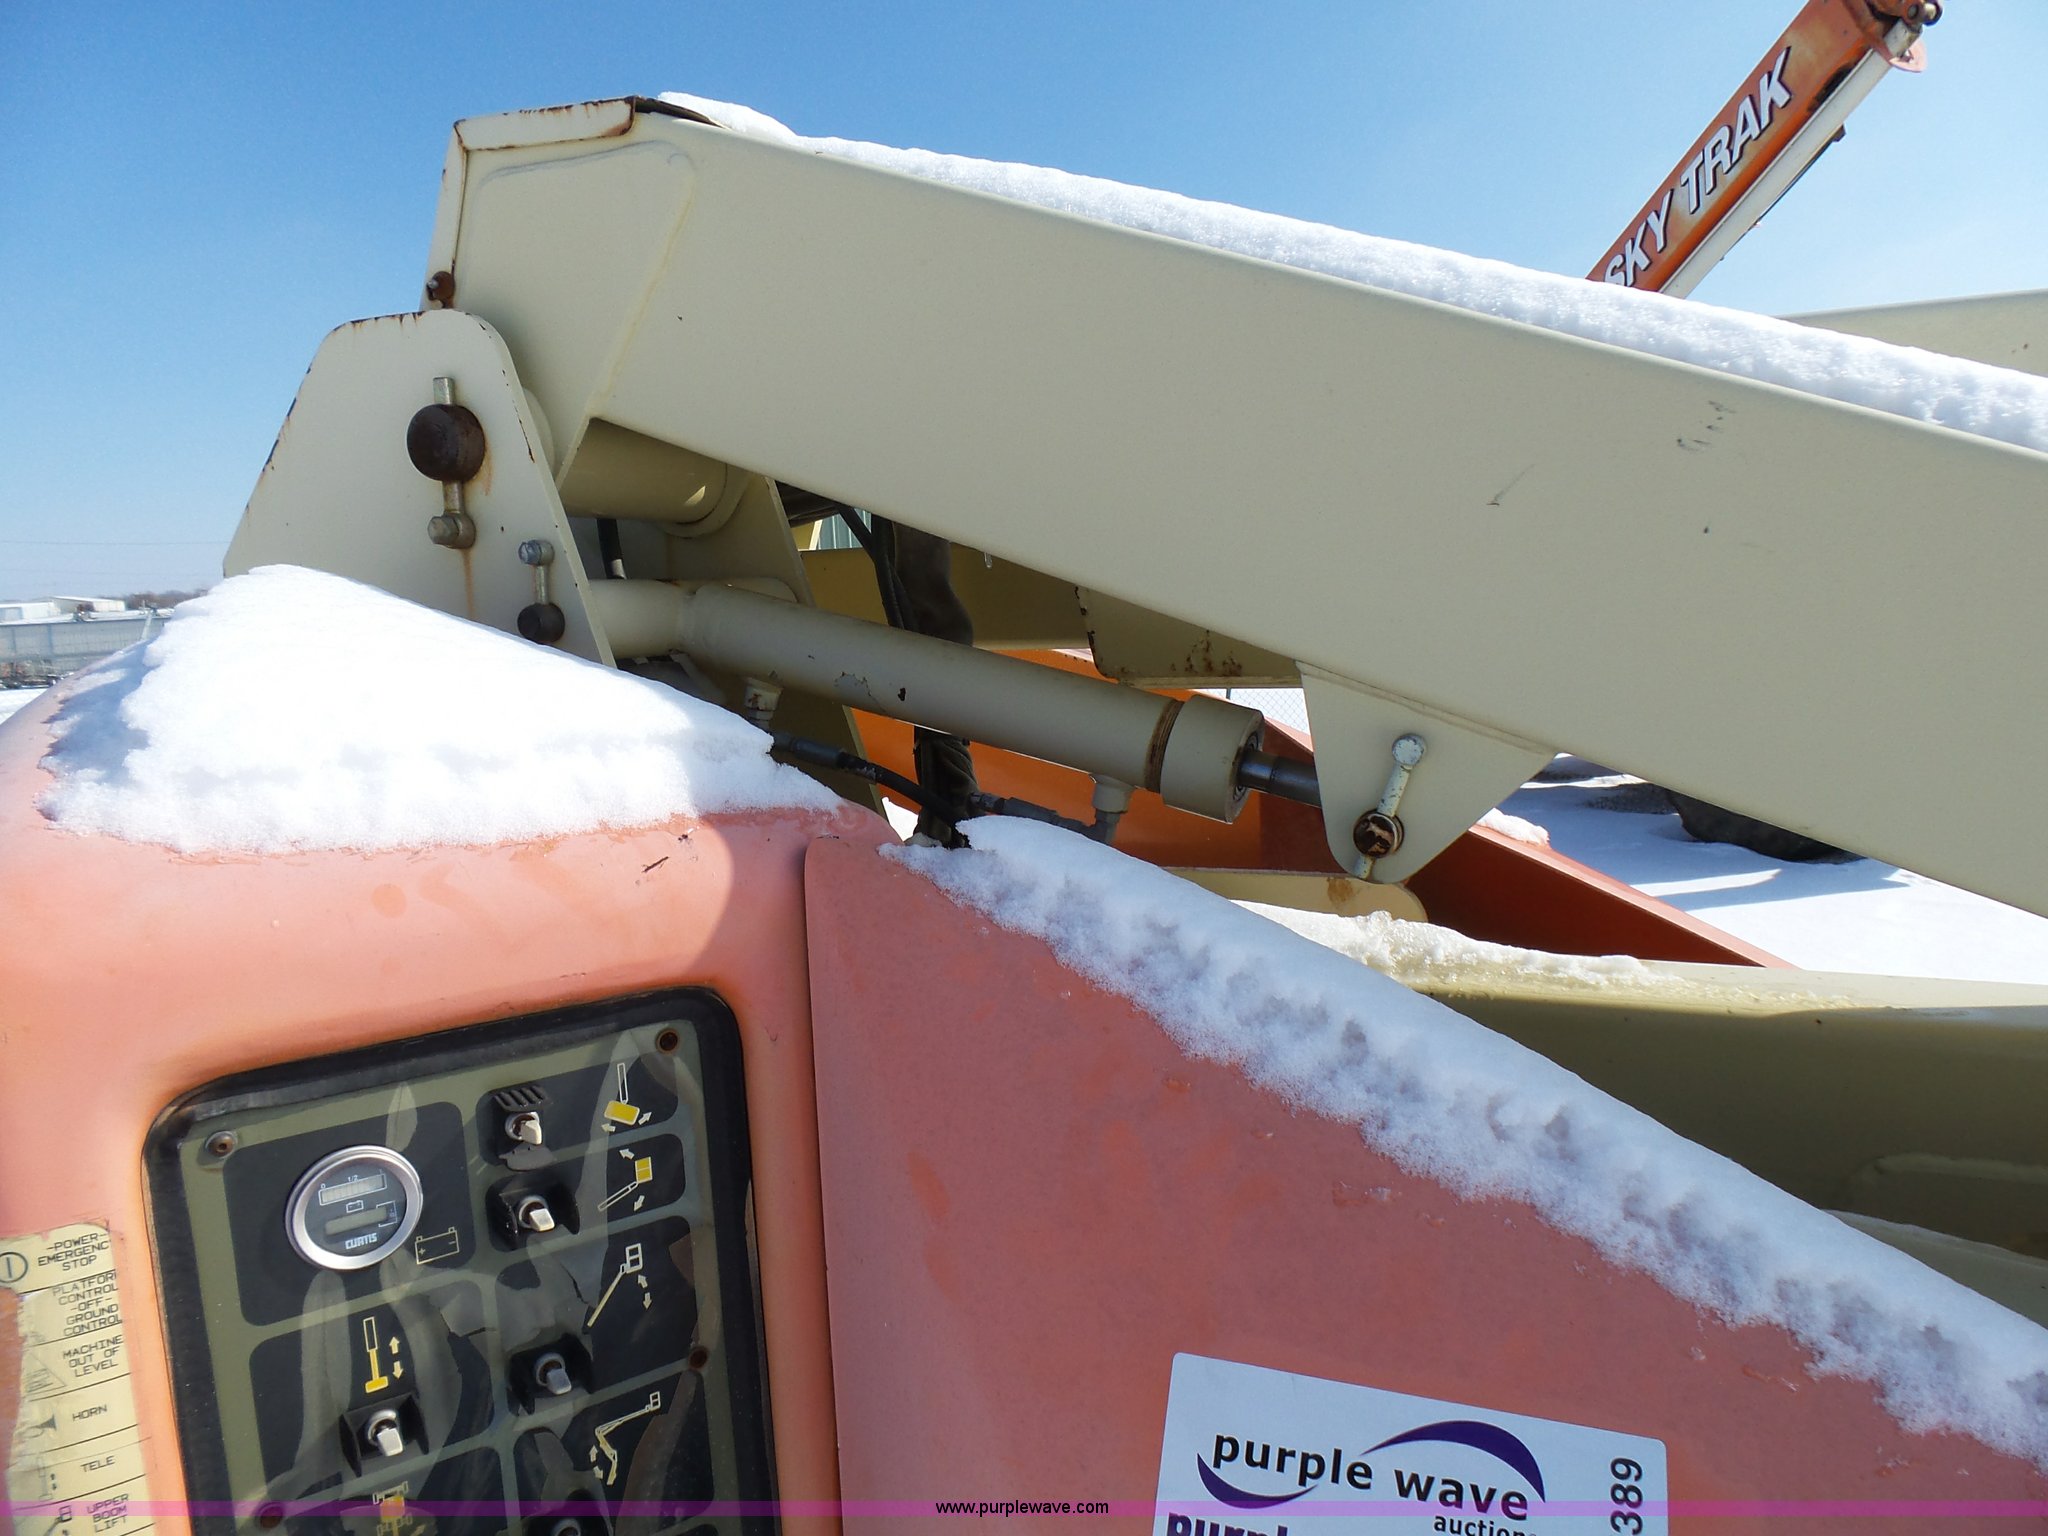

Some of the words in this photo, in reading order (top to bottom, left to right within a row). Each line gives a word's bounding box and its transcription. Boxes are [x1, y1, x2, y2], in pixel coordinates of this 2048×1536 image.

[1604, 188, 1674, 287] SKY
[1680, 46, 1792, 215] TRAK
[345, 1232, 378, 1250] CURTIS
[37, 1239, 111, 1267] EMERGENC
[62, 1254, 97, 1271] STOP
[58, 1283, 119, 1306] CONTROL
[66, 1303, 119, 1325] GROUND
[63, 1314, 123, 1337] CONTROL
[62, 1334, 124, 1360] MACHINE
[68, 1353, 94, 1368] OUT
[103, 1345, 120, 1359] OF
[74, 1358, 119, 1378] LEVEL
[72, 1405, 108, 1422] HORN
[80, 1455, 116, 1473] TELE
[1212, 1434, 1373, 1490] purple
[1394, 1469, 1528, 1521] wave
[86, 1493, 129, 1514] UPPER
[1610, 1457, 1643, 1535] 389
[92, 1504, 128, 1523] BOOM
[94, 1514, 128, 1533] LIFT
